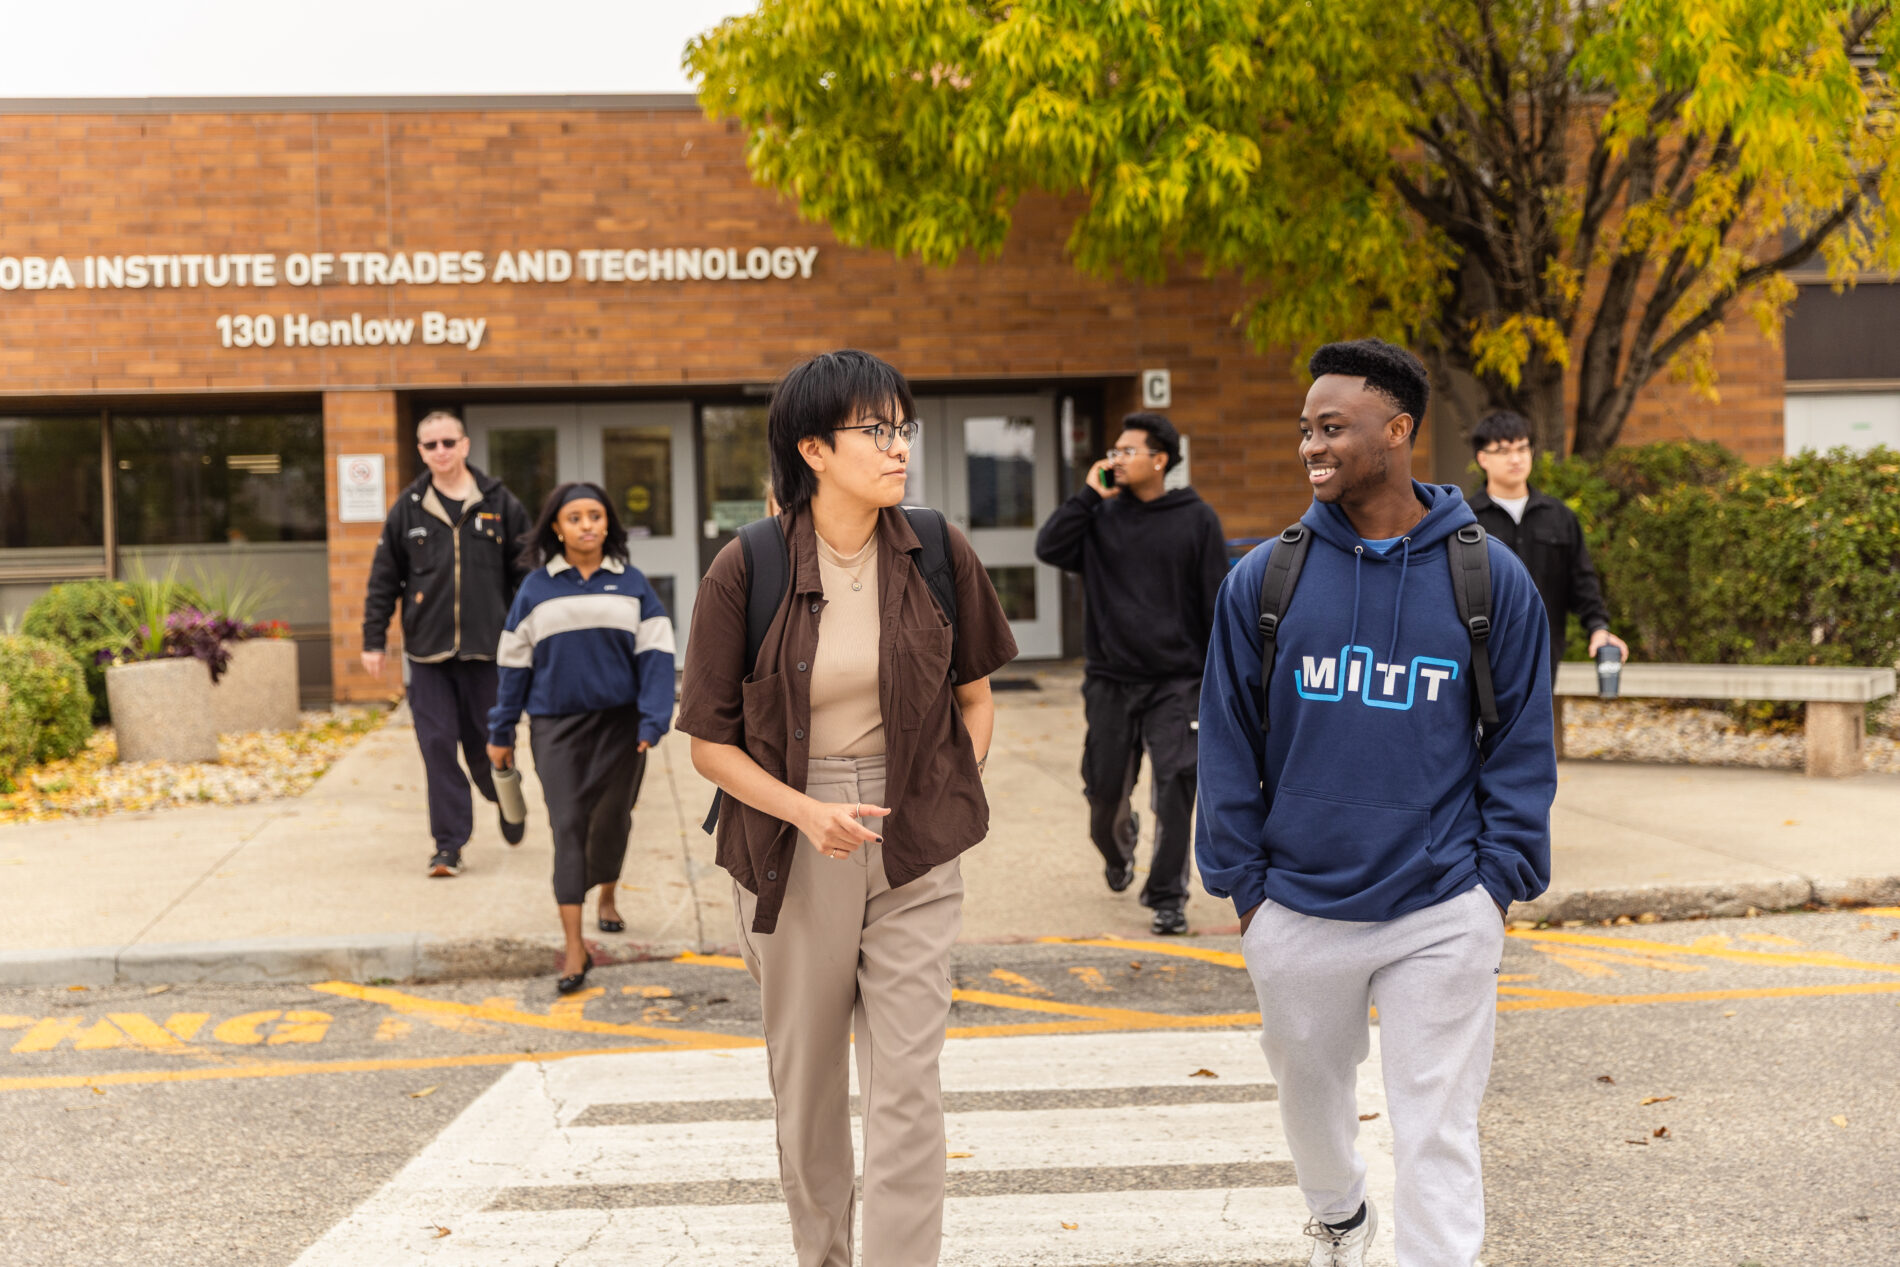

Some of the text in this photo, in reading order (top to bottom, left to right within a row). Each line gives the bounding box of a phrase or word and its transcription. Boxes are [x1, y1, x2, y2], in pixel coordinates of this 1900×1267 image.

[84, 254, 277, 289] INSTITUTE
[285, 252, 334, 287] OF
[340, 250, 487, 286] TRADES
[492, 249, 573, 284] AND
[577, 246, 819, 282] TECHNOLOGY
[216, 310, 487, 351] 130 Henlow Bay
[1149, 375, 1164, 401] C
[1302, 656, 1449, 702] MITT
